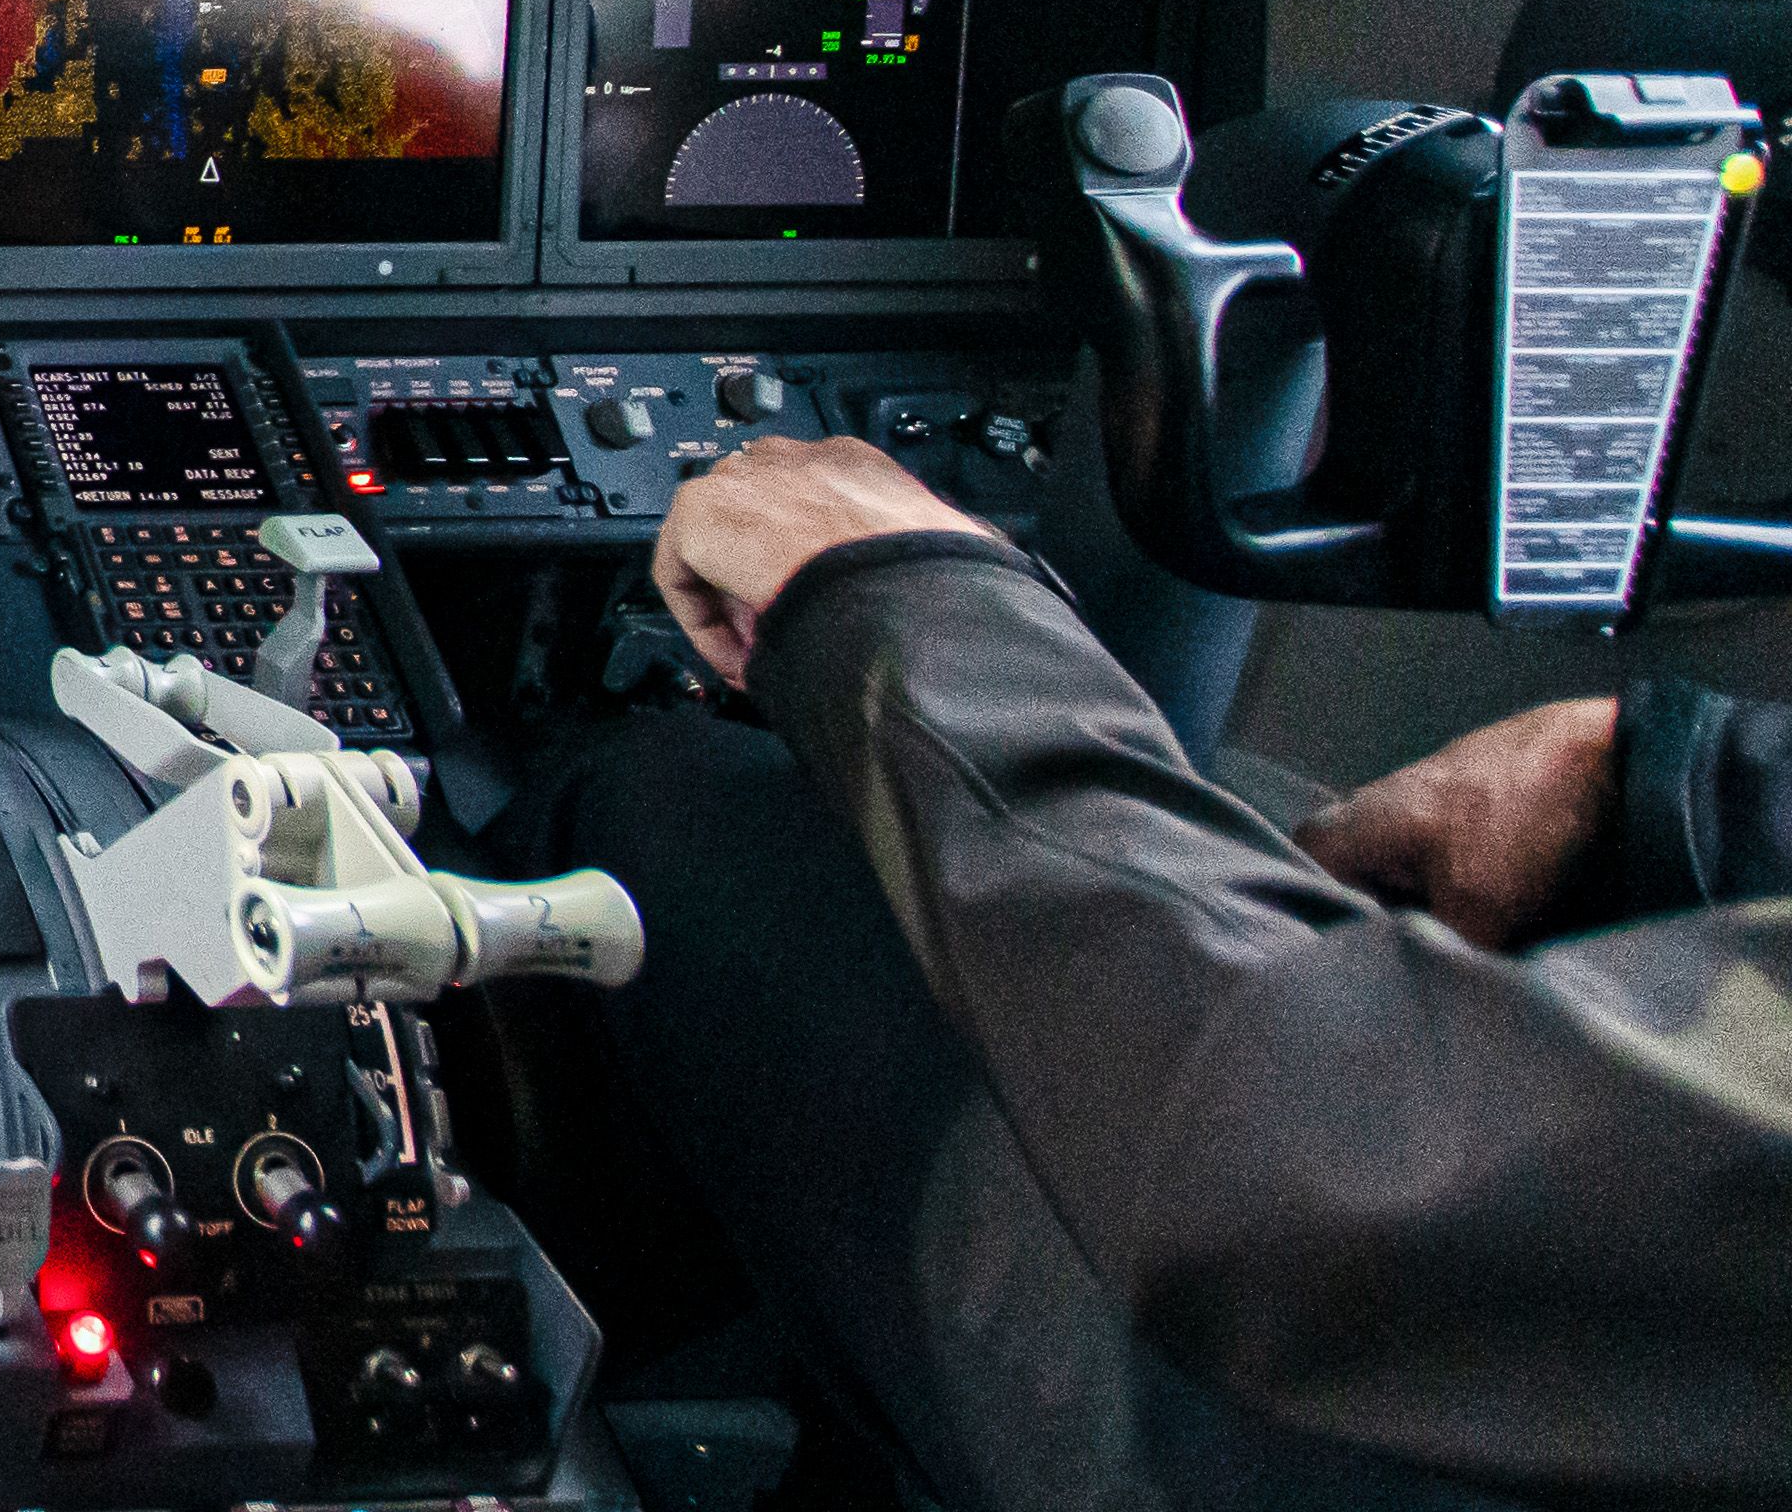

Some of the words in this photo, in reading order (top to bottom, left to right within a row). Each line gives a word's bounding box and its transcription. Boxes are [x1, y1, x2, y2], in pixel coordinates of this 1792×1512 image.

[185, 469, 218, 479] DATA
[298, 527, 344, 538] FLAP
[183, 1127, 215, 1143] IDLE
